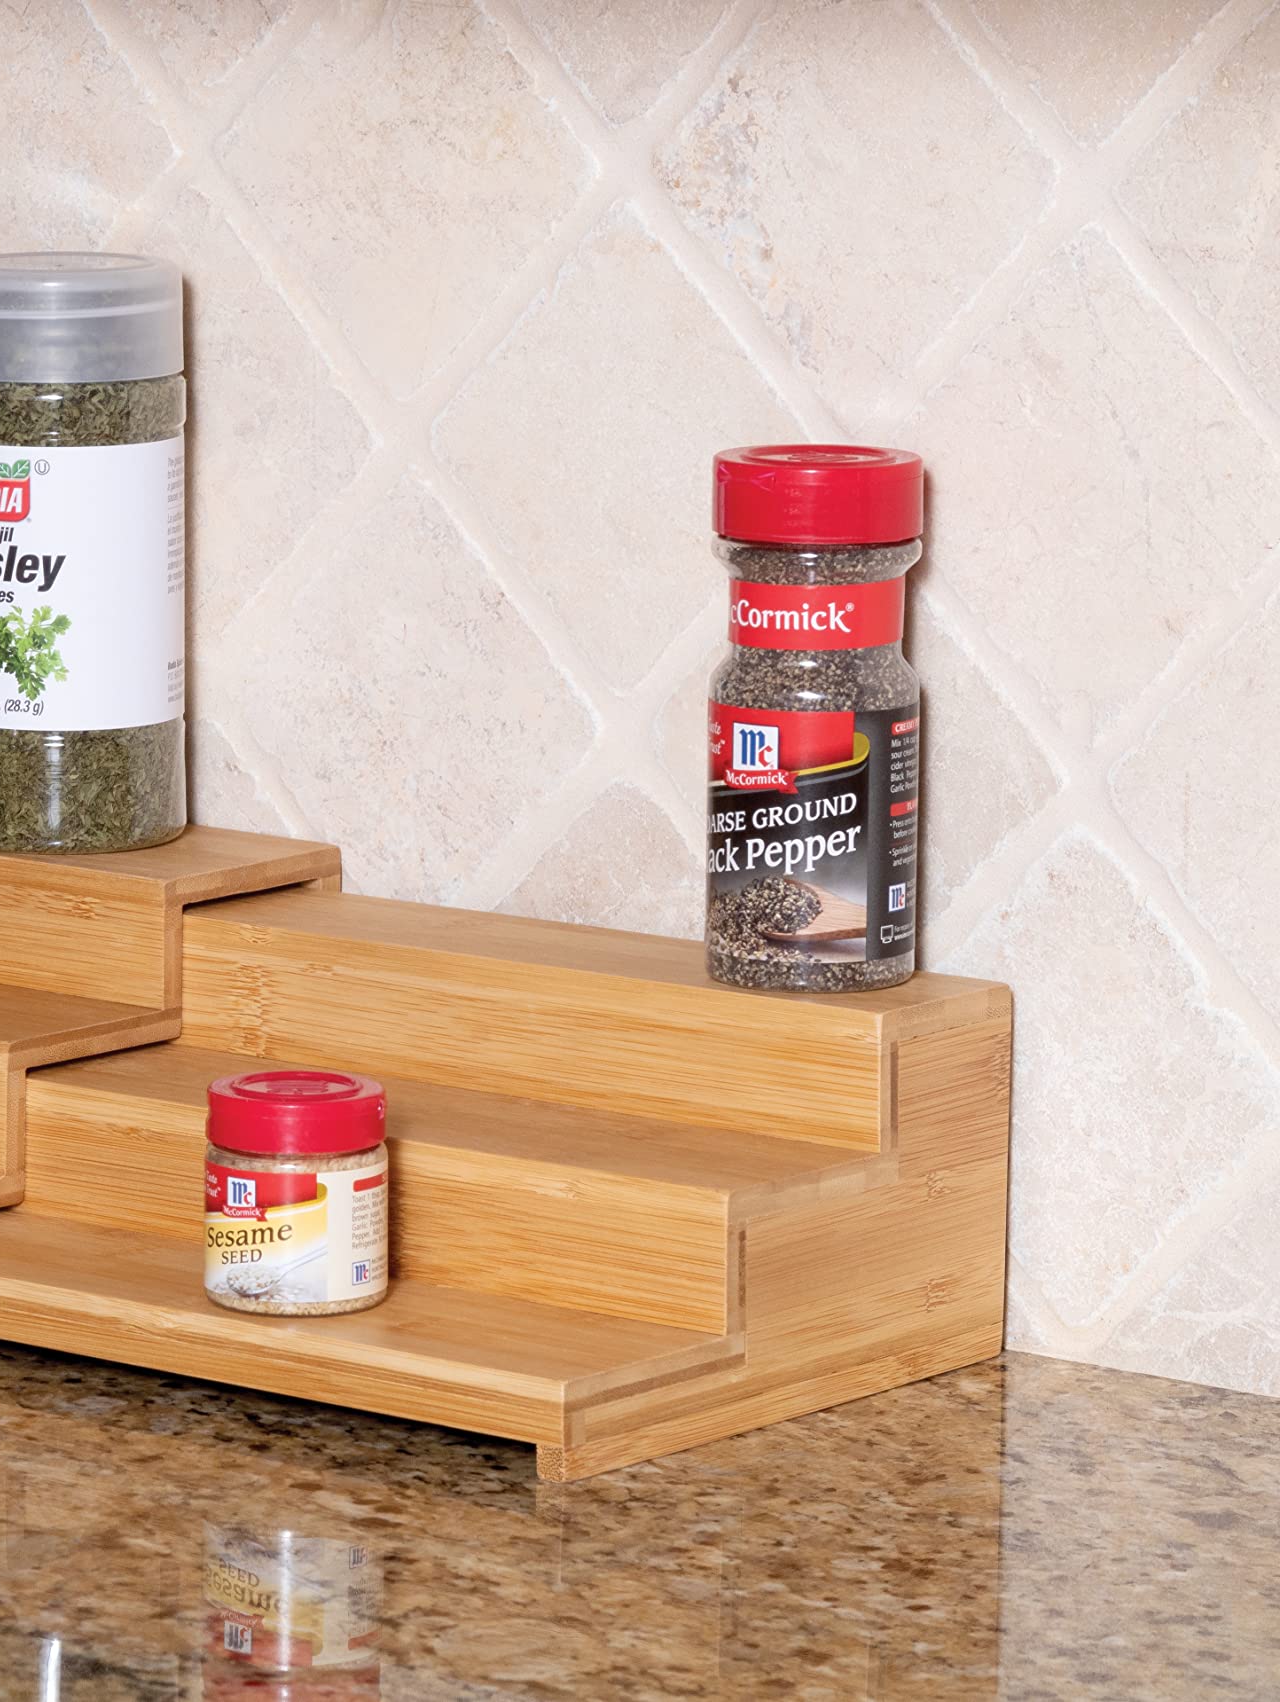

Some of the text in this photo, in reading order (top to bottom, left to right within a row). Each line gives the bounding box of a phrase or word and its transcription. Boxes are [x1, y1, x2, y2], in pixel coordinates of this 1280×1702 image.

[32, 700, 44, 716] g)
[726, 770, 787, 786] McCormick
[890, 771, 904, 782] Black
[890, 783, 905, 793] Garlic
[752, 793, 857, 829] GROUND
[746, 825, 861, 876] Pepper
[223, 1205, 261, 1217] McCormick
[207, 1224, 293, 1248] Sesame
[221, 1249, 262, 1265] SEED
